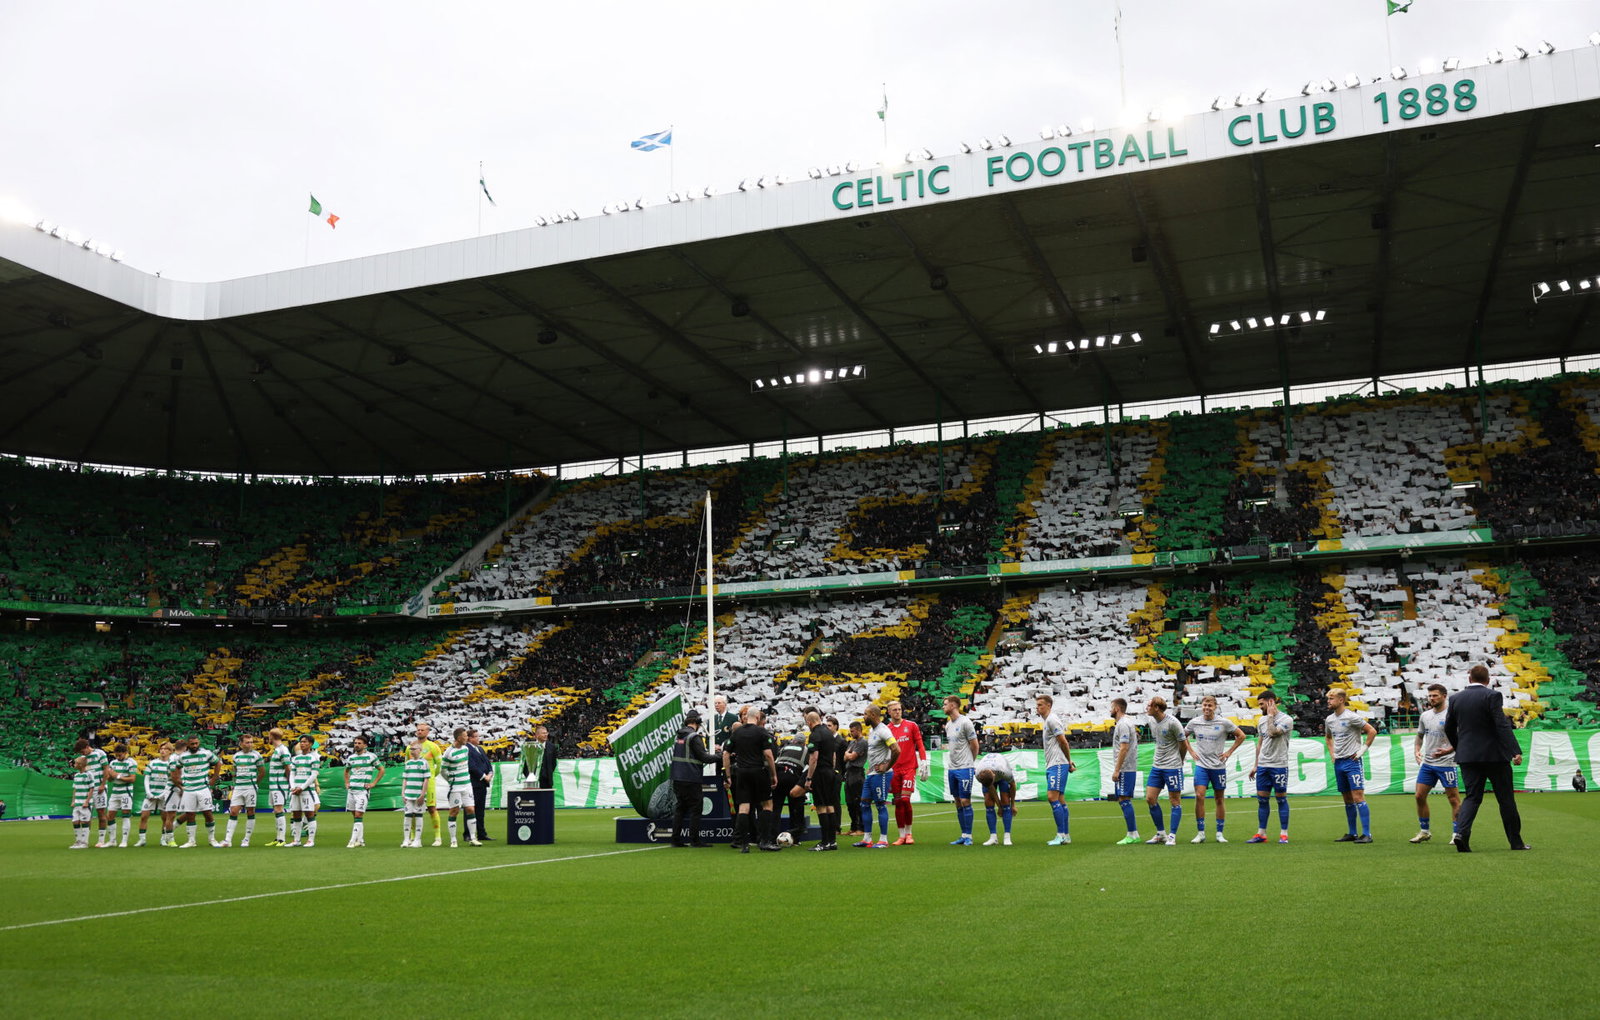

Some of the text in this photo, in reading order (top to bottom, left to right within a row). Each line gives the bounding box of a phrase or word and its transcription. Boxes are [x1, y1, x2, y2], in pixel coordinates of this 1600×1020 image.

[831, 79, 1477, 211] CELTIC FOOTBALL CLUB 1888
[618, 712, 683, 771] PREMIERSHIP
[1050, 775, 1056, 785] 5
[1168, 776, 1178, 786] 51
[1218, 774, 1226, 784] 15
[1274, 774, 1286, 784] 22
[1352, 774, 1361, 784] 12
[1444, 771, 1454, 781] 10
[902, 779, 912, 788] 20
[962, 779, 970, 789] 17
[876, 787, 882, 796] 9
[302, 797, 309, 805] 41
